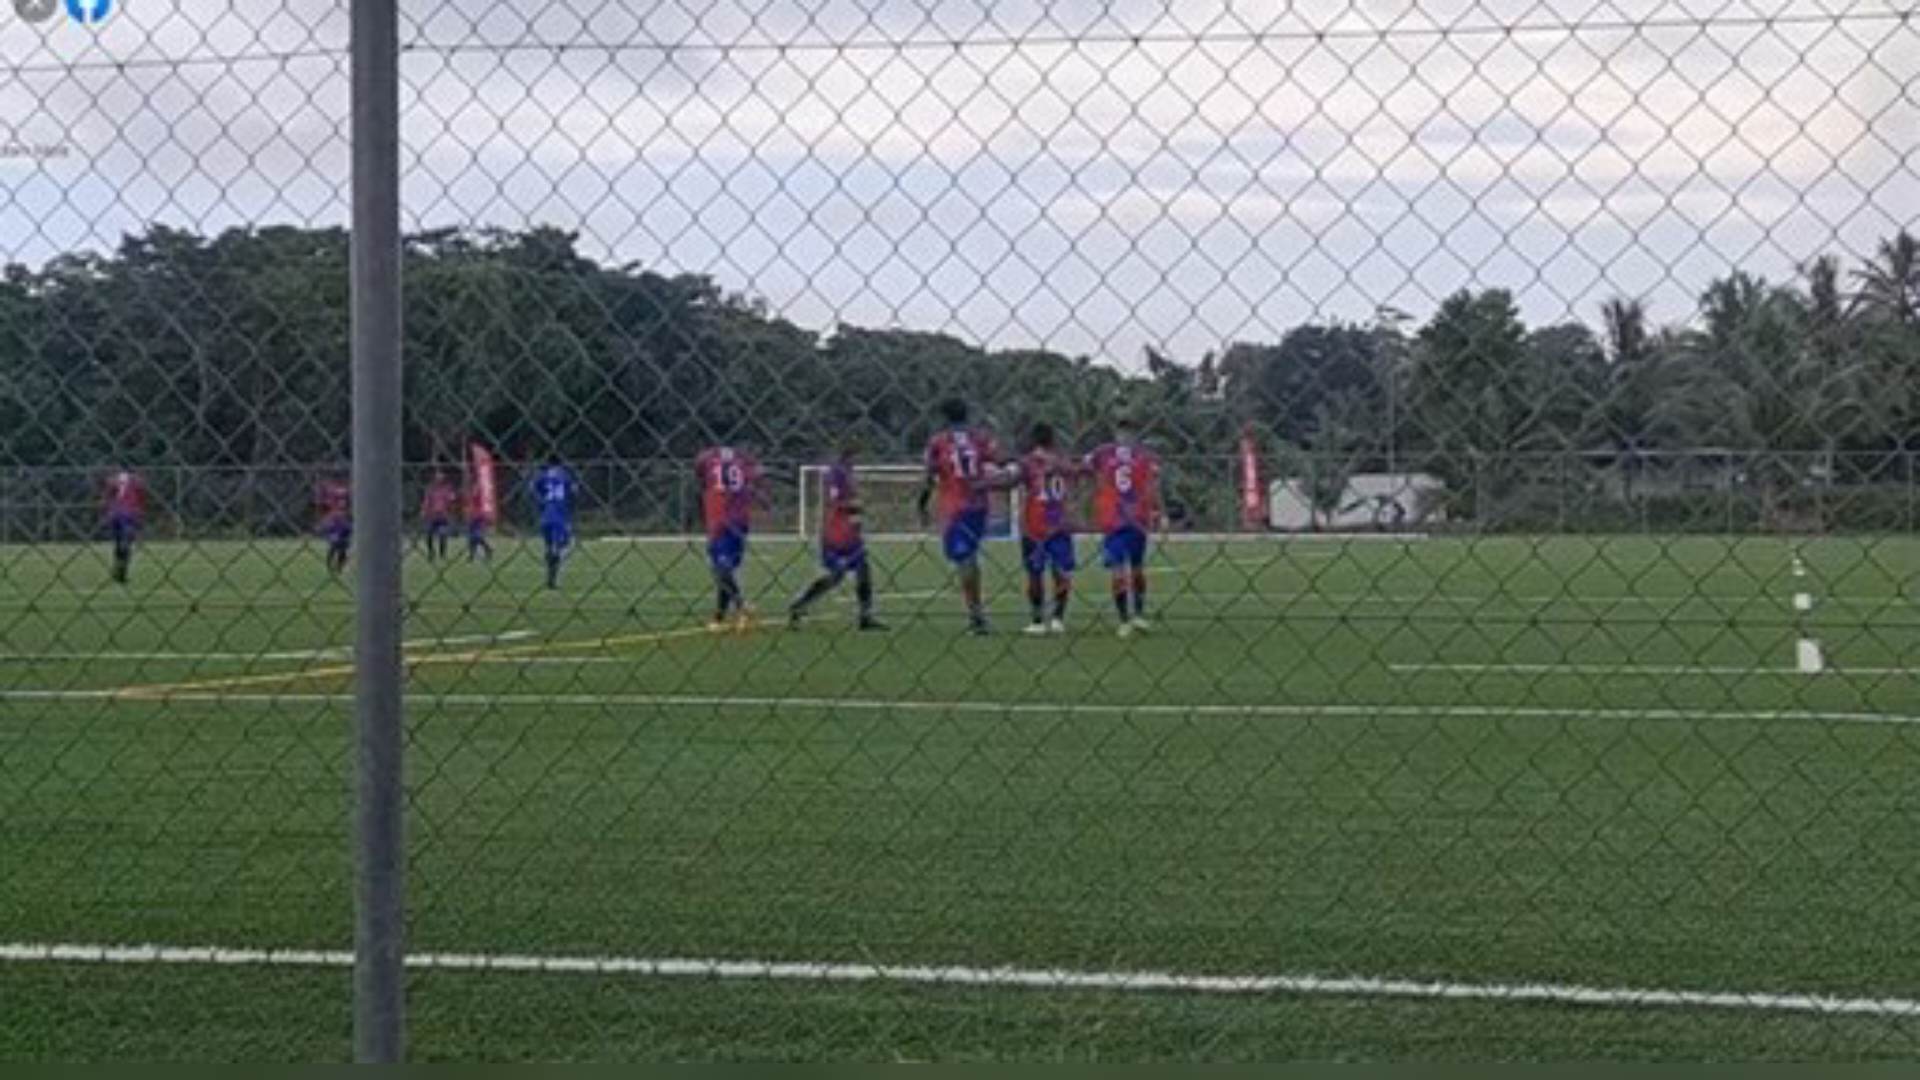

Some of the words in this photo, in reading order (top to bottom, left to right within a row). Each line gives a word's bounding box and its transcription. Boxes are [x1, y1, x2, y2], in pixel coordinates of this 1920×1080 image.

[712, 464, 744, 491] 19
[950, 449, 978, 479] 17
[1037, 474, 1065, 500] 10
[1115, 464, 1132, 493] 6
